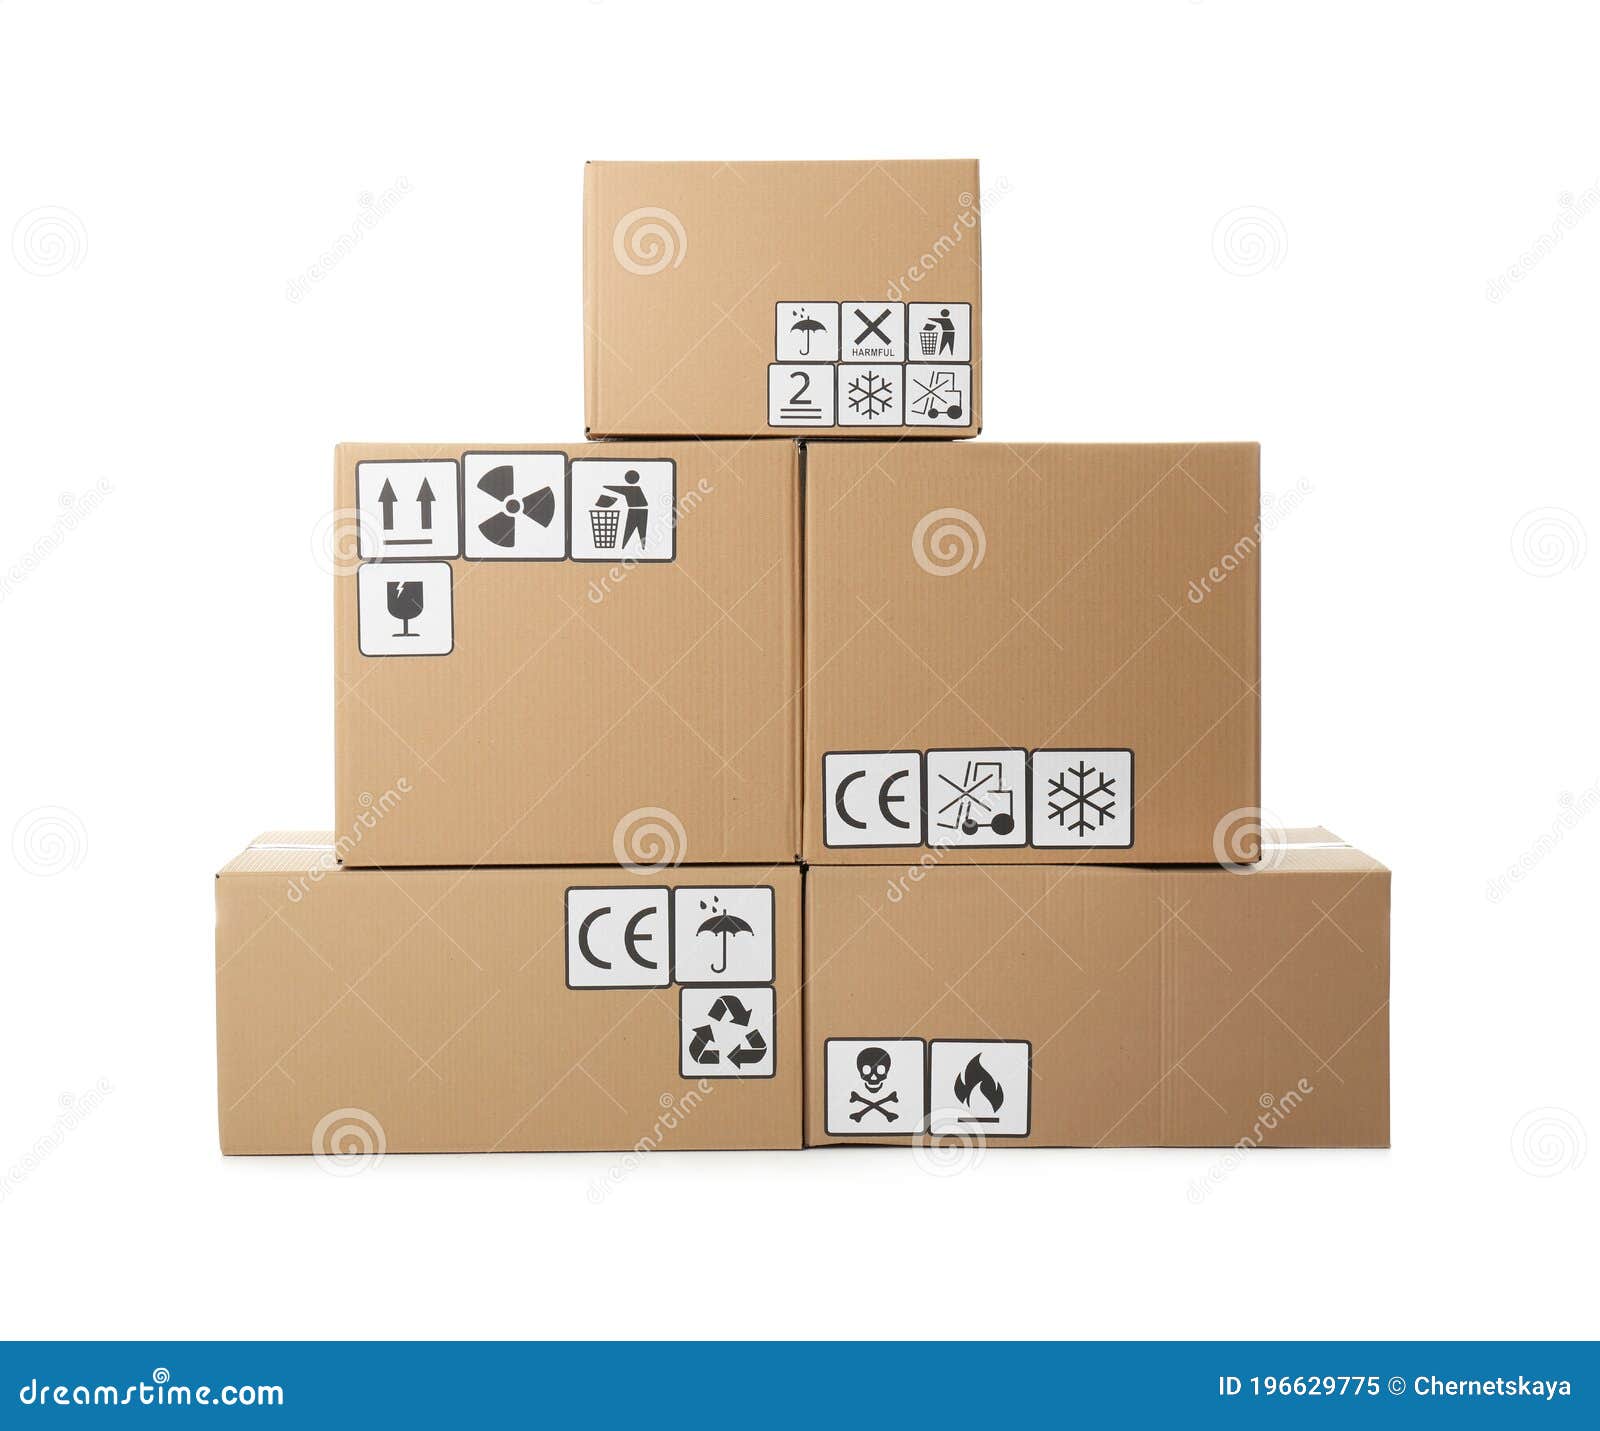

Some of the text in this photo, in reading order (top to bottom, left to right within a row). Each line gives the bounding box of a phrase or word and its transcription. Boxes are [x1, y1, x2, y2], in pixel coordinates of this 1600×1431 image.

[852, 347, 895, 357] HARMFUL
[789, 371, 812, 405] 2
[835, 769, 910, 830] CE
[578, 906, 658, 970] CE
